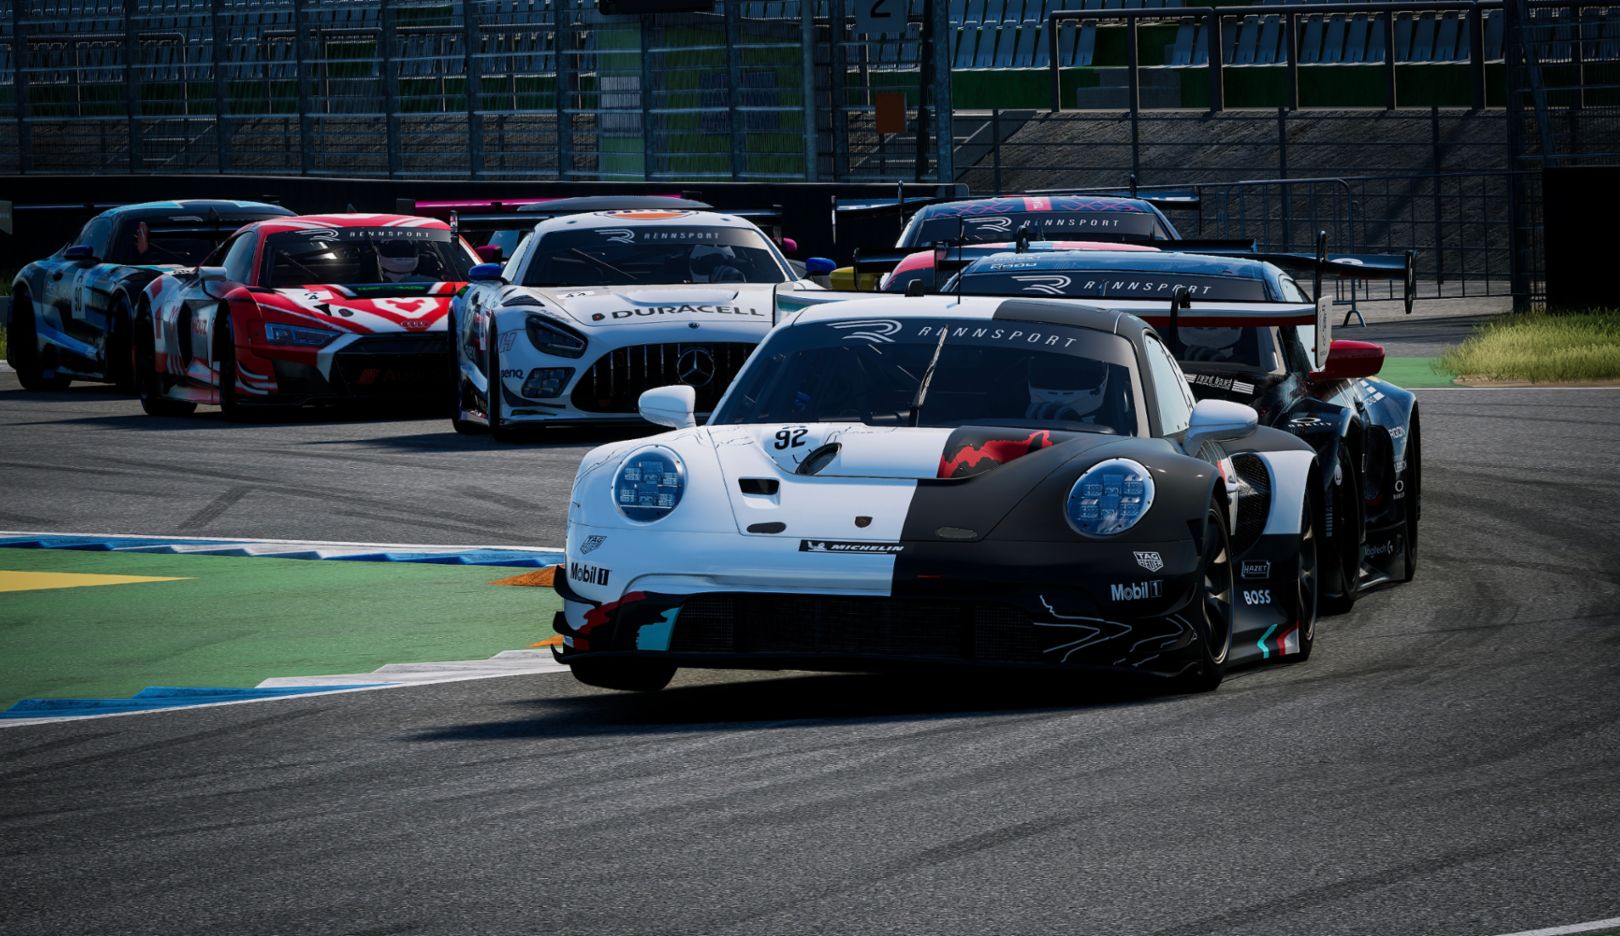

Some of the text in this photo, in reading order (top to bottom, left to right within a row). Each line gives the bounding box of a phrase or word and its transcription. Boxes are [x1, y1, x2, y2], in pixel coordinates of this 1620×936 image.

[349, 230, 430, 239] RENNSPORT
[643, 231, 720, 240] RENNSPORT
[611, 304, 766, 319] DURACELL
[774, 428, 809, 450] 92
[830, 542, 905, 552] MICHELIN
[1137, 552, 1160, 560] TAG
[570, 561, 597, 584] Mobil
[1243, 564, 1269, 574] HAZET
[1110, 580, 1149, 601] Mobil
[1243, 588, 1272, 605] BOSS
